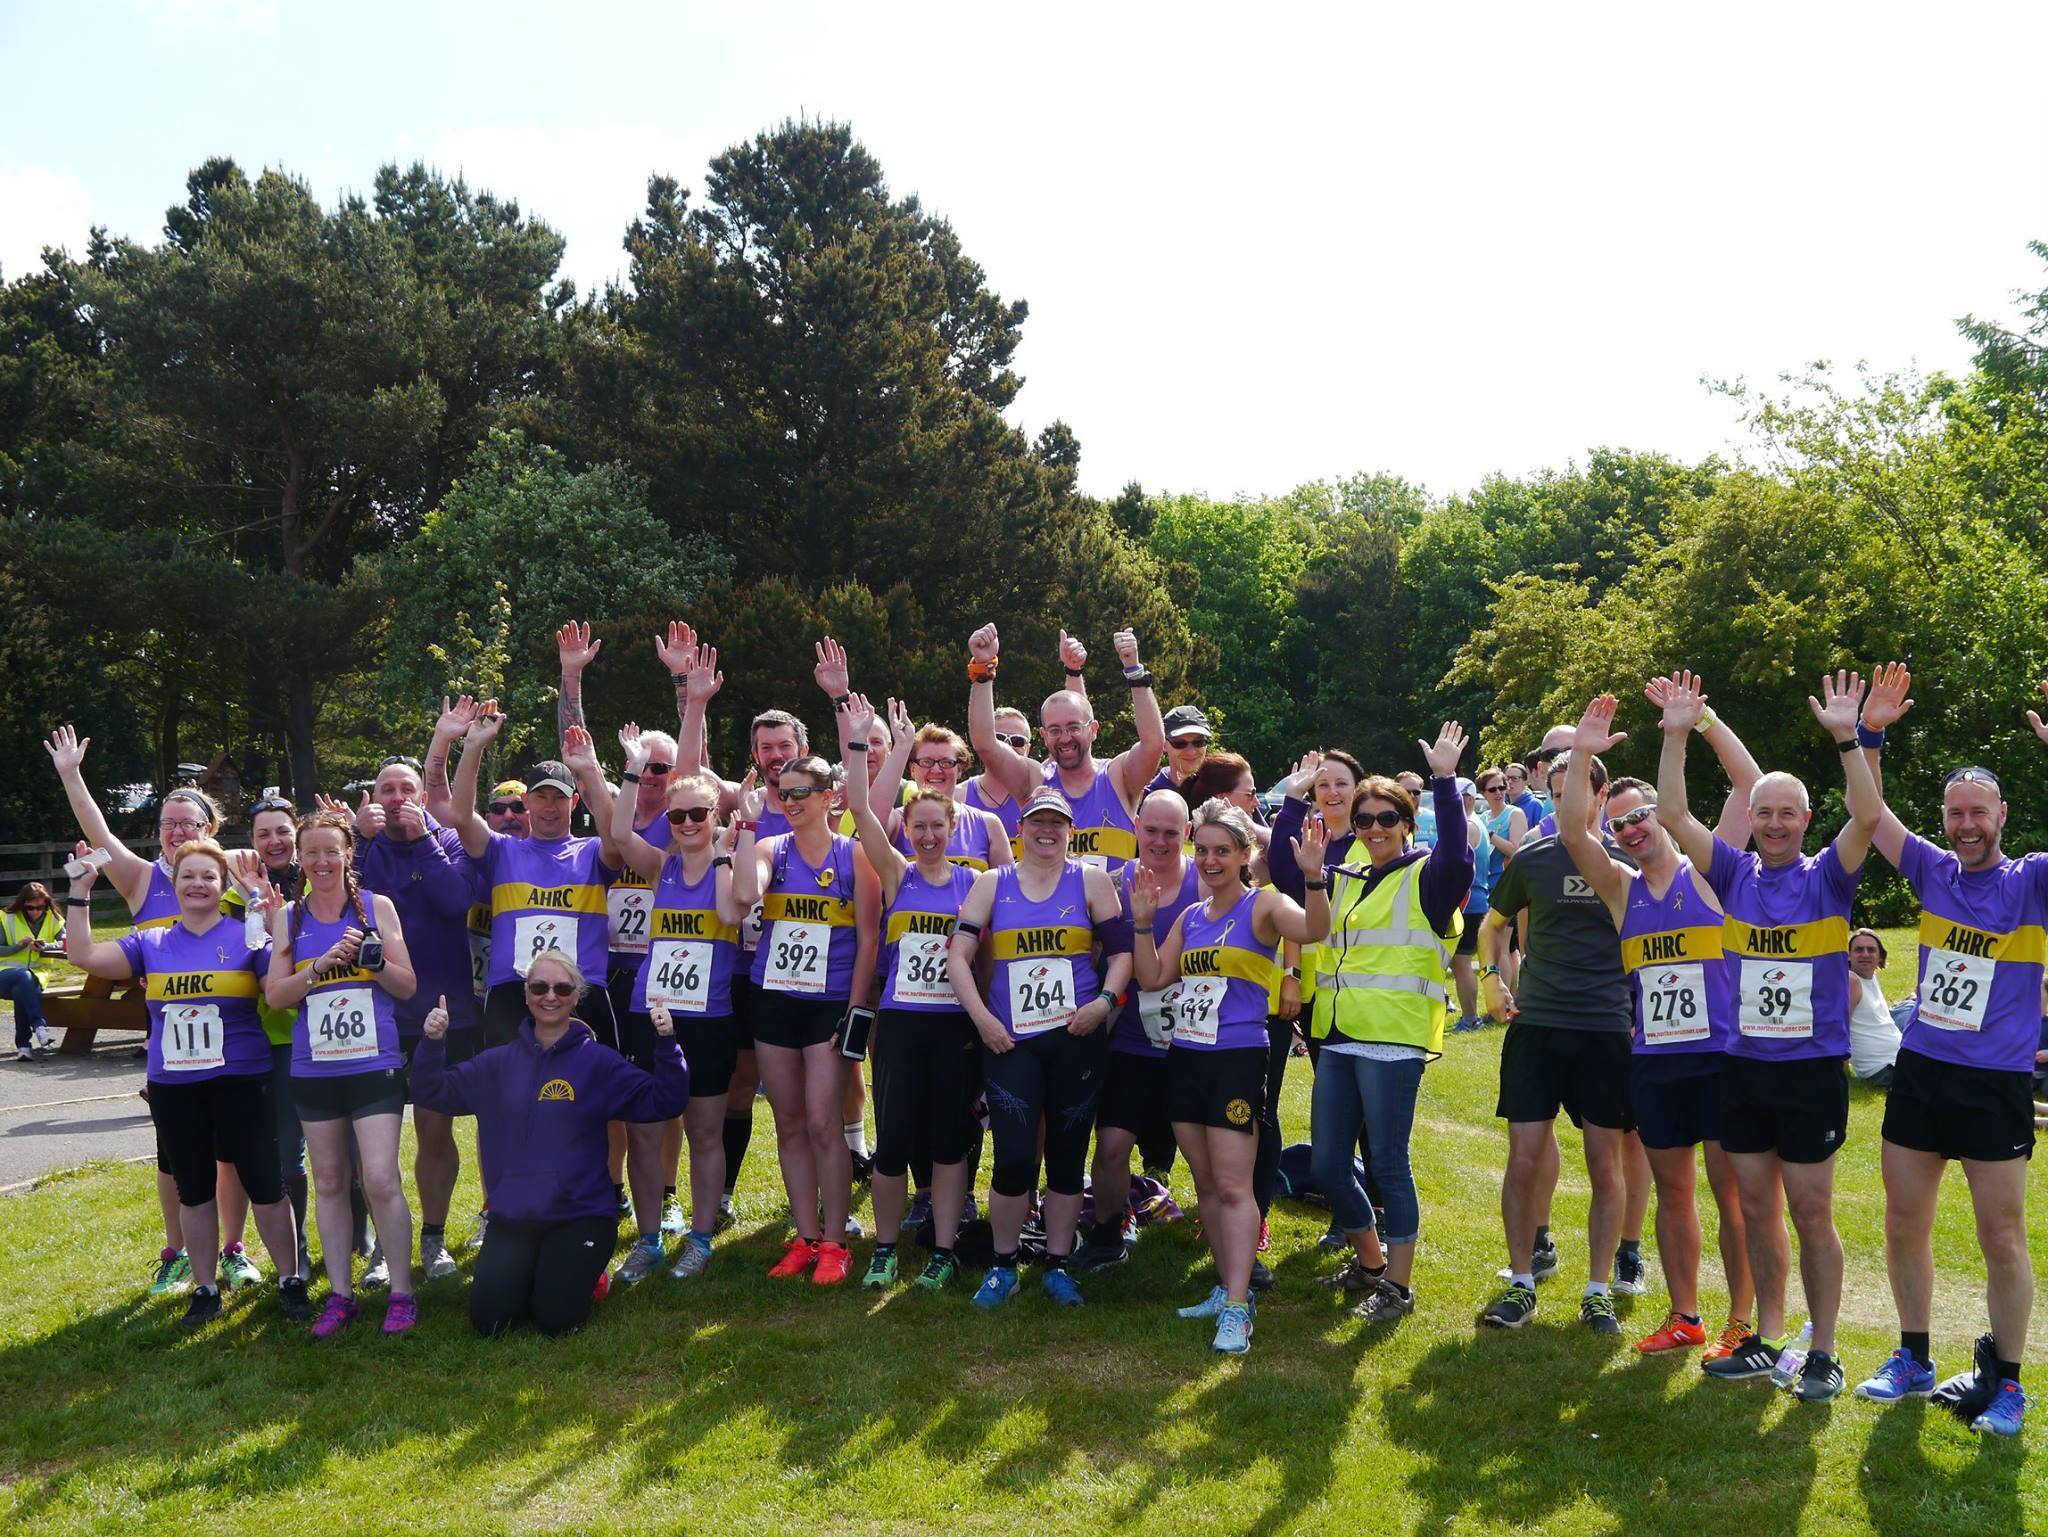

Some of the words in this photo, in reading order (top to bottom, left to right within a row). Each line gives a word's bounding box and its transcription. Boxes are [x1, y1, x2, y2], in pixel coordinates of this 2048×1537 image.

[527, 888, 574, 908] AHRC
[784, 898, 829, 921] AHRC
[619, 909, 647, 935] 22
[660, 913, 704, 935] AHRC
[909, 915, 956, 936] AHRC
[1016, 929, 1067, 954] AHRC
[1642, 933, 1687, 962] AHRC
[1746, 928, 1797, 953] AHRC
[1942, 926, 1998, 959] AHRC
[775, 943, 818, 972] 392
[907, 955, 950, 983] 362
[1183, 949, 1220, 975] AHRC
[163, 974, 214, 996] AHRC
[656, 962, 699, 991] 466
[1019, 980, 1065, 1012] 264
[1650, 988, 1697, 1022] 278
[1759, 986, 1792, 1016] 39
[1929, 973, 1978, 1011] 262
[320, 1010, 365, 1041] 468
[1160, 1006, 1175, 1031] 5
[174, 1022, 210, 1050] 111
